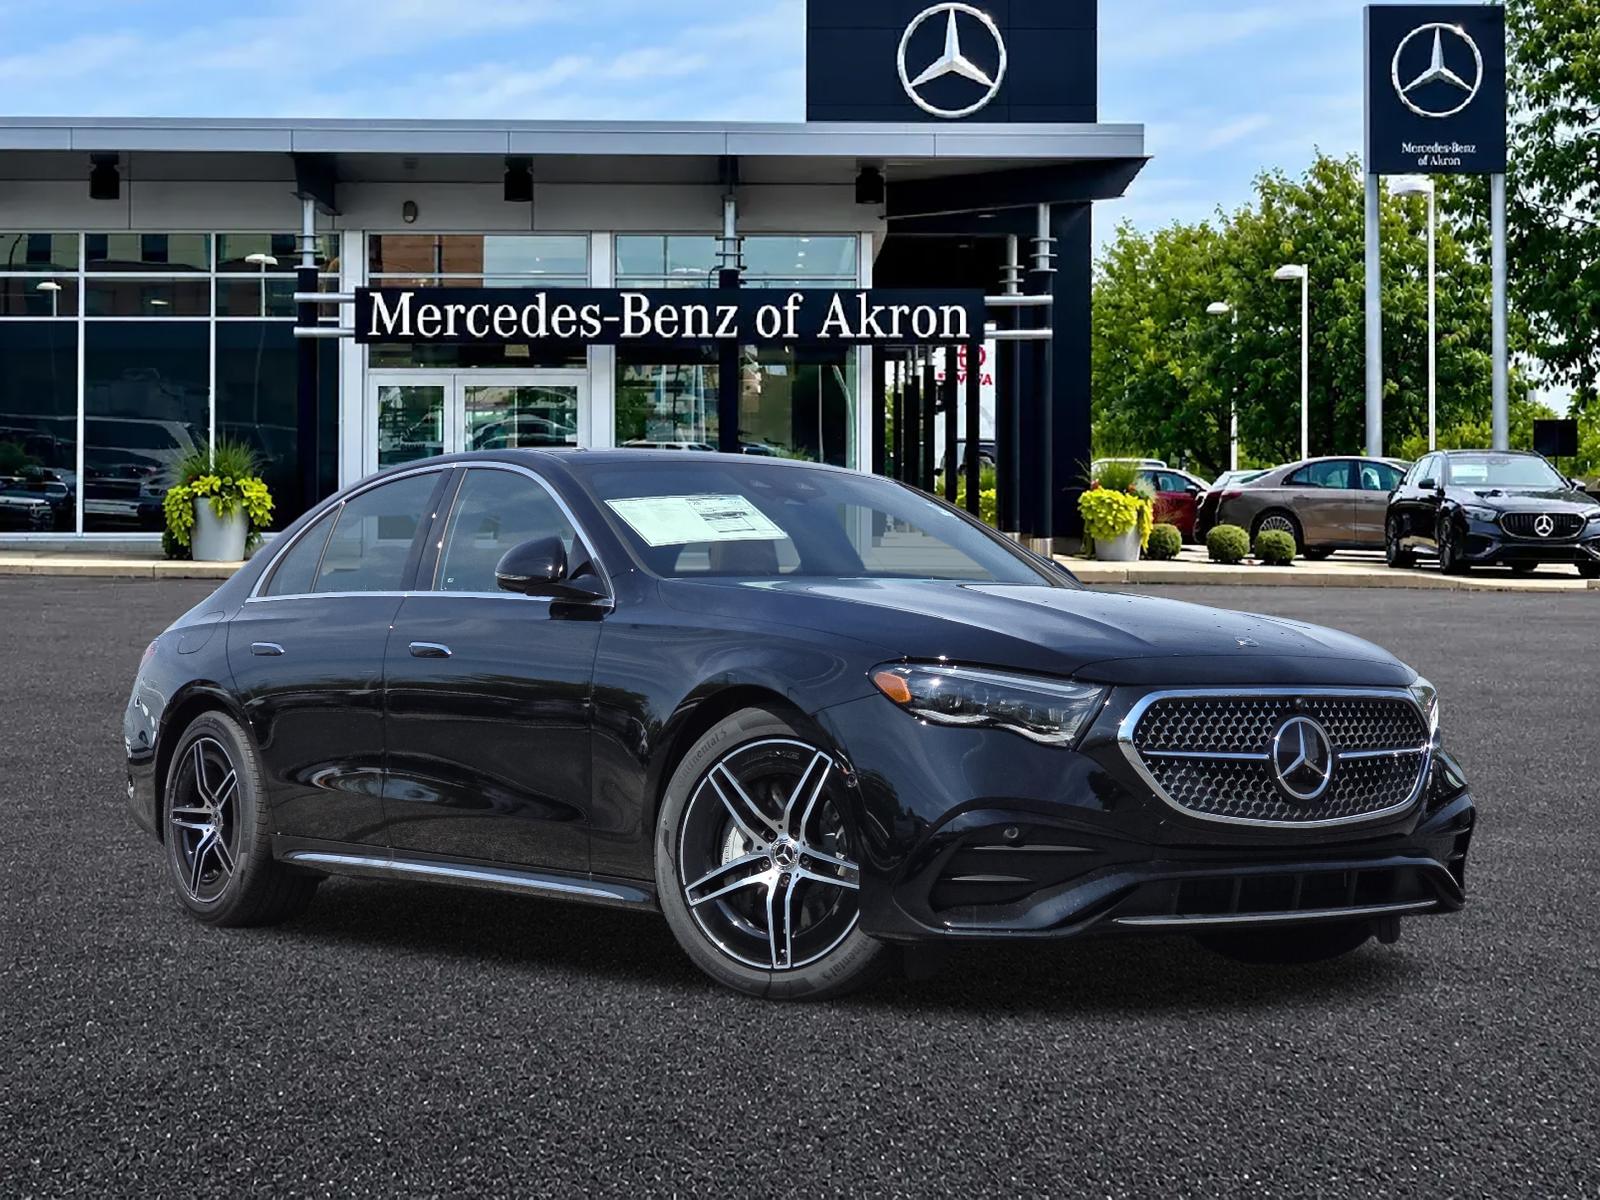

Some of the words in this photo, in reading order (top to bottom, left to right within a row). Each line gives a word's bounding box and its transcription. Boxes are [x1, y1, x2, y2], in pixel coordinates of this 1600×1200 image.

[1401, 141, 1477, 154] Mercedes-Benz
[1417, 154, 1429, 166] of
[1430, 154, 1461, 166] Akron
[367, 290, 738, 338] Mercedes-Benz
[755, 292, 805, 338] of
[816, 290, 972, 338] Akron
